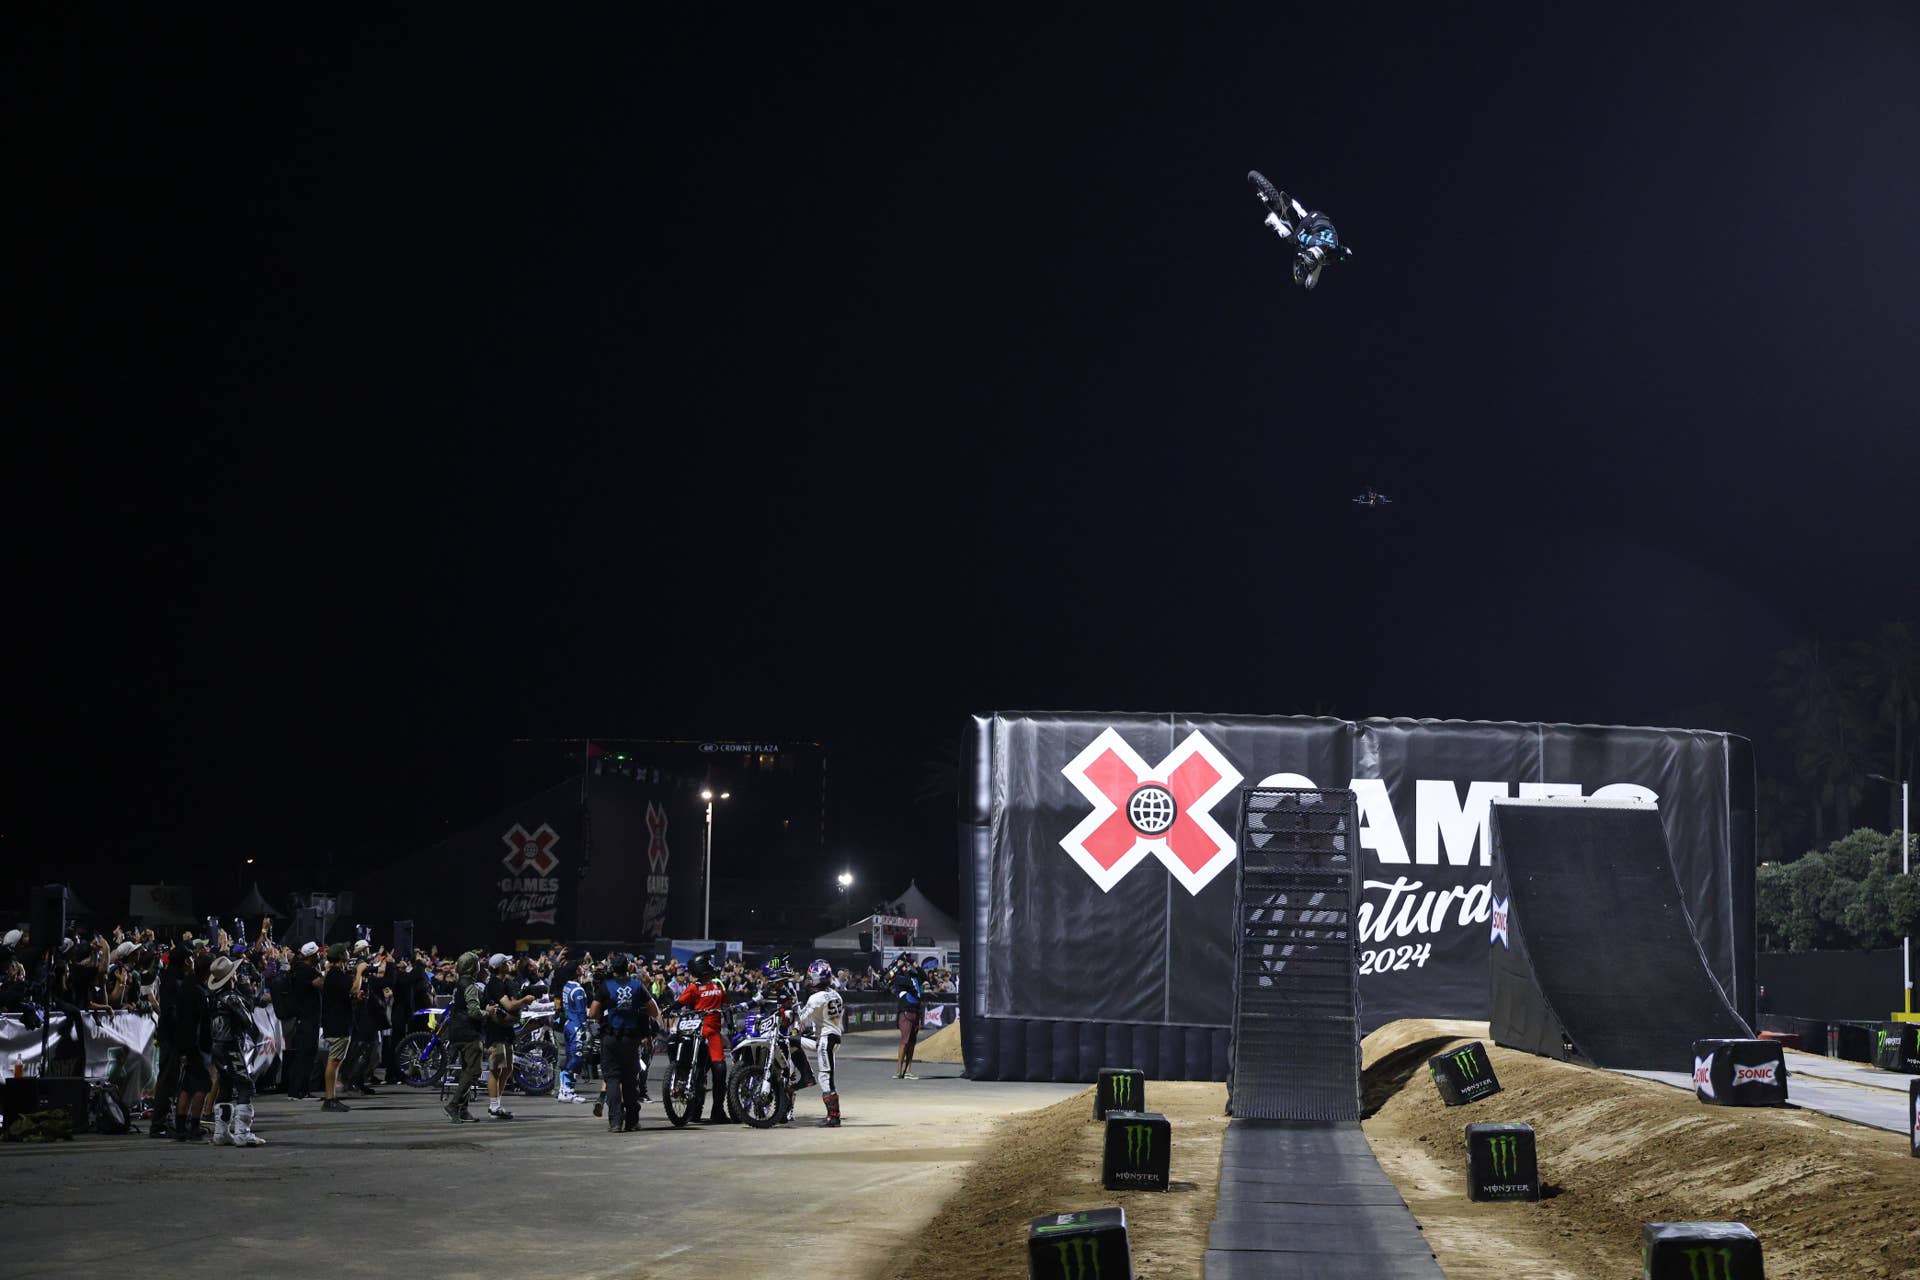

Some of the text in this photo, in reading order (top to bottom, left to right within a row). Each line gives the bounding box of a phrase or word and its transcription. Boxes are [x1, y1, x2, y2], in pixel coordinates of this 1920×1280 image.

[720, 744, 751, 752] CROWNE
[755, 744, 779, 752] PLAZA
[501, 878, 559, 892] GAMES
[1359, 943, 1432, 976] 2024
[1738, 1068, 1774, 1079] SONIC
[1460, 1078, 1493, 1095] MONSTER
[1115, 1171, 1160, 1181] MONSTER
[1483, 1184, 1529, 1193] MONSTER
